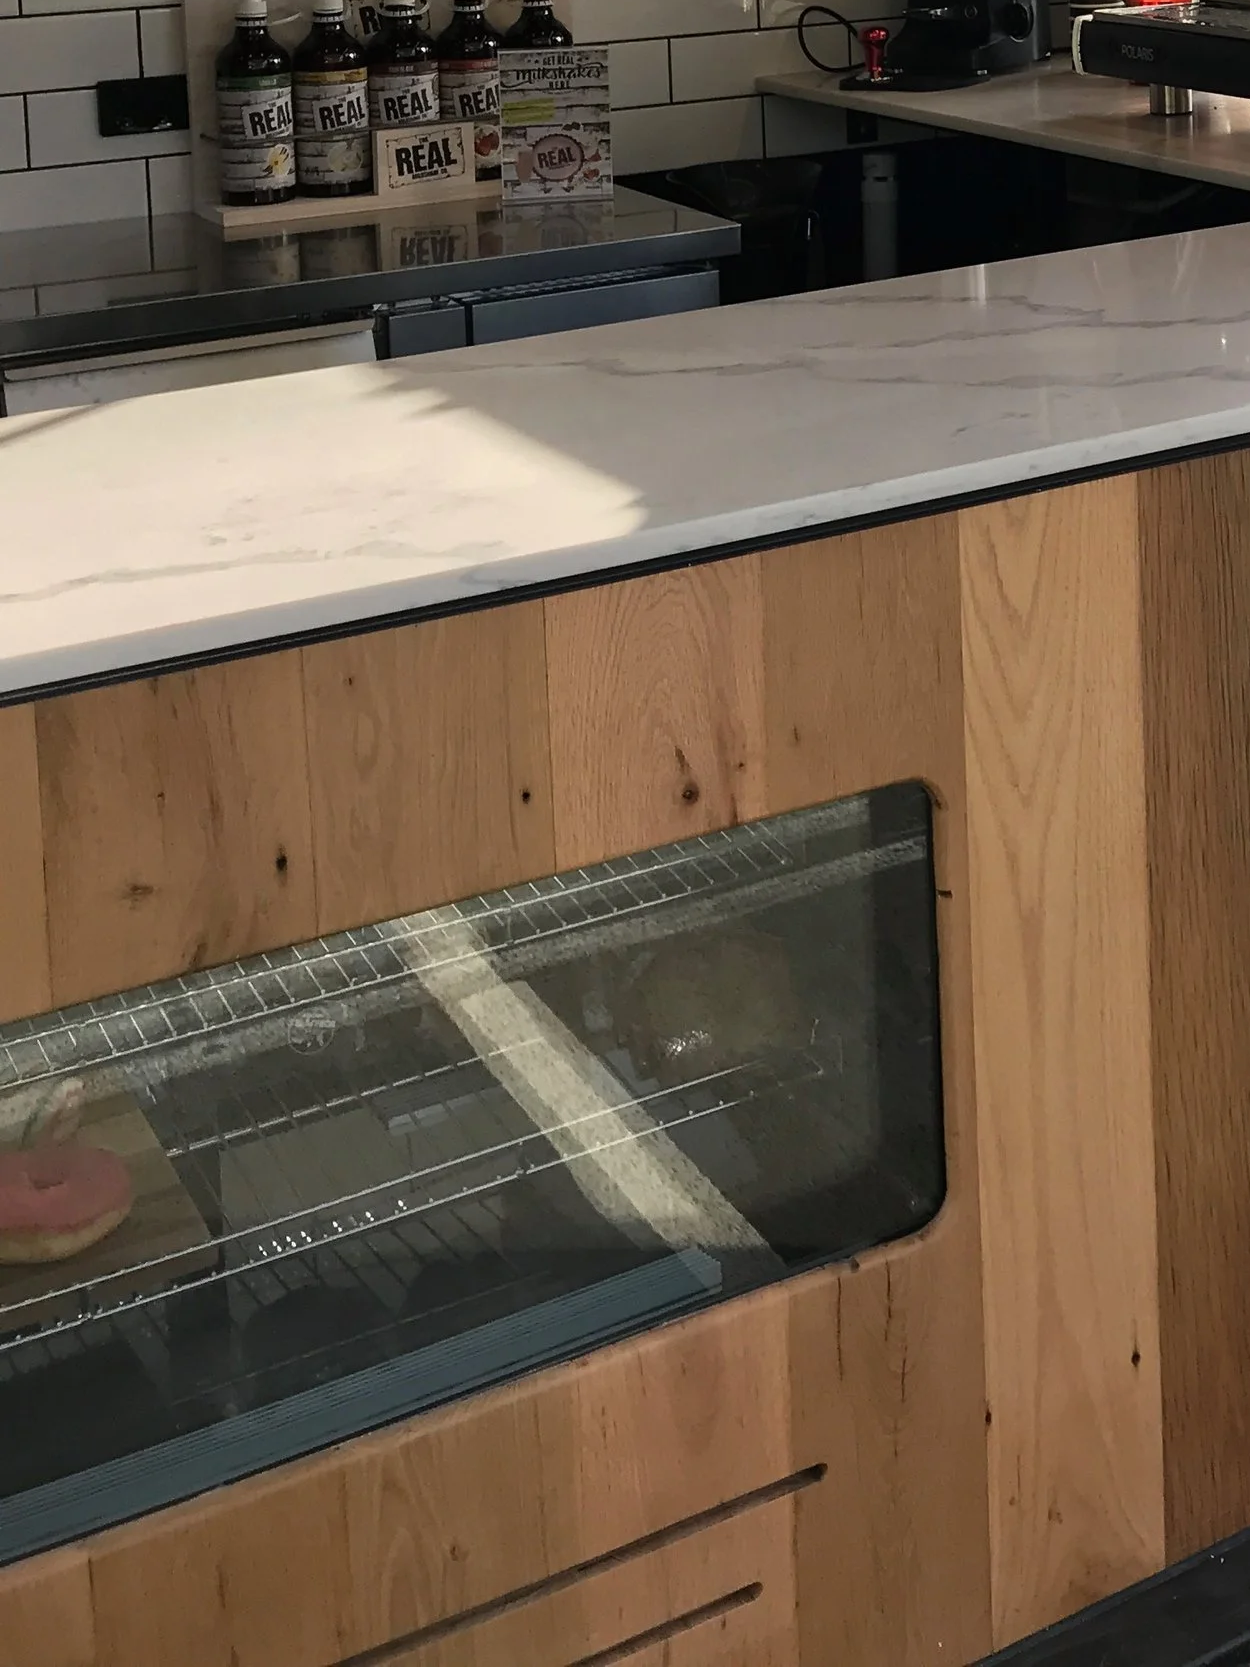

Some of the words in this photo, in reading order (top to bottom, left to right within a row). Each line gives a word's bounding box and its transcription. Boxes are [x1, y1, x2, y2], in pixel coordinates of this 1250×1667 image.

[557, 55, 574, 64] REAL
[1121, 44, 1154, 62] POLARIS
[549, 80, 570, 89] HERE
[319, 96, 365, 130] REAL
[384, 88, 432, 120] REAL
[249, 101, 292, 136] REAL
[395, 138, 457, 176] REAL
[538, 147, 576, 168] REAL
